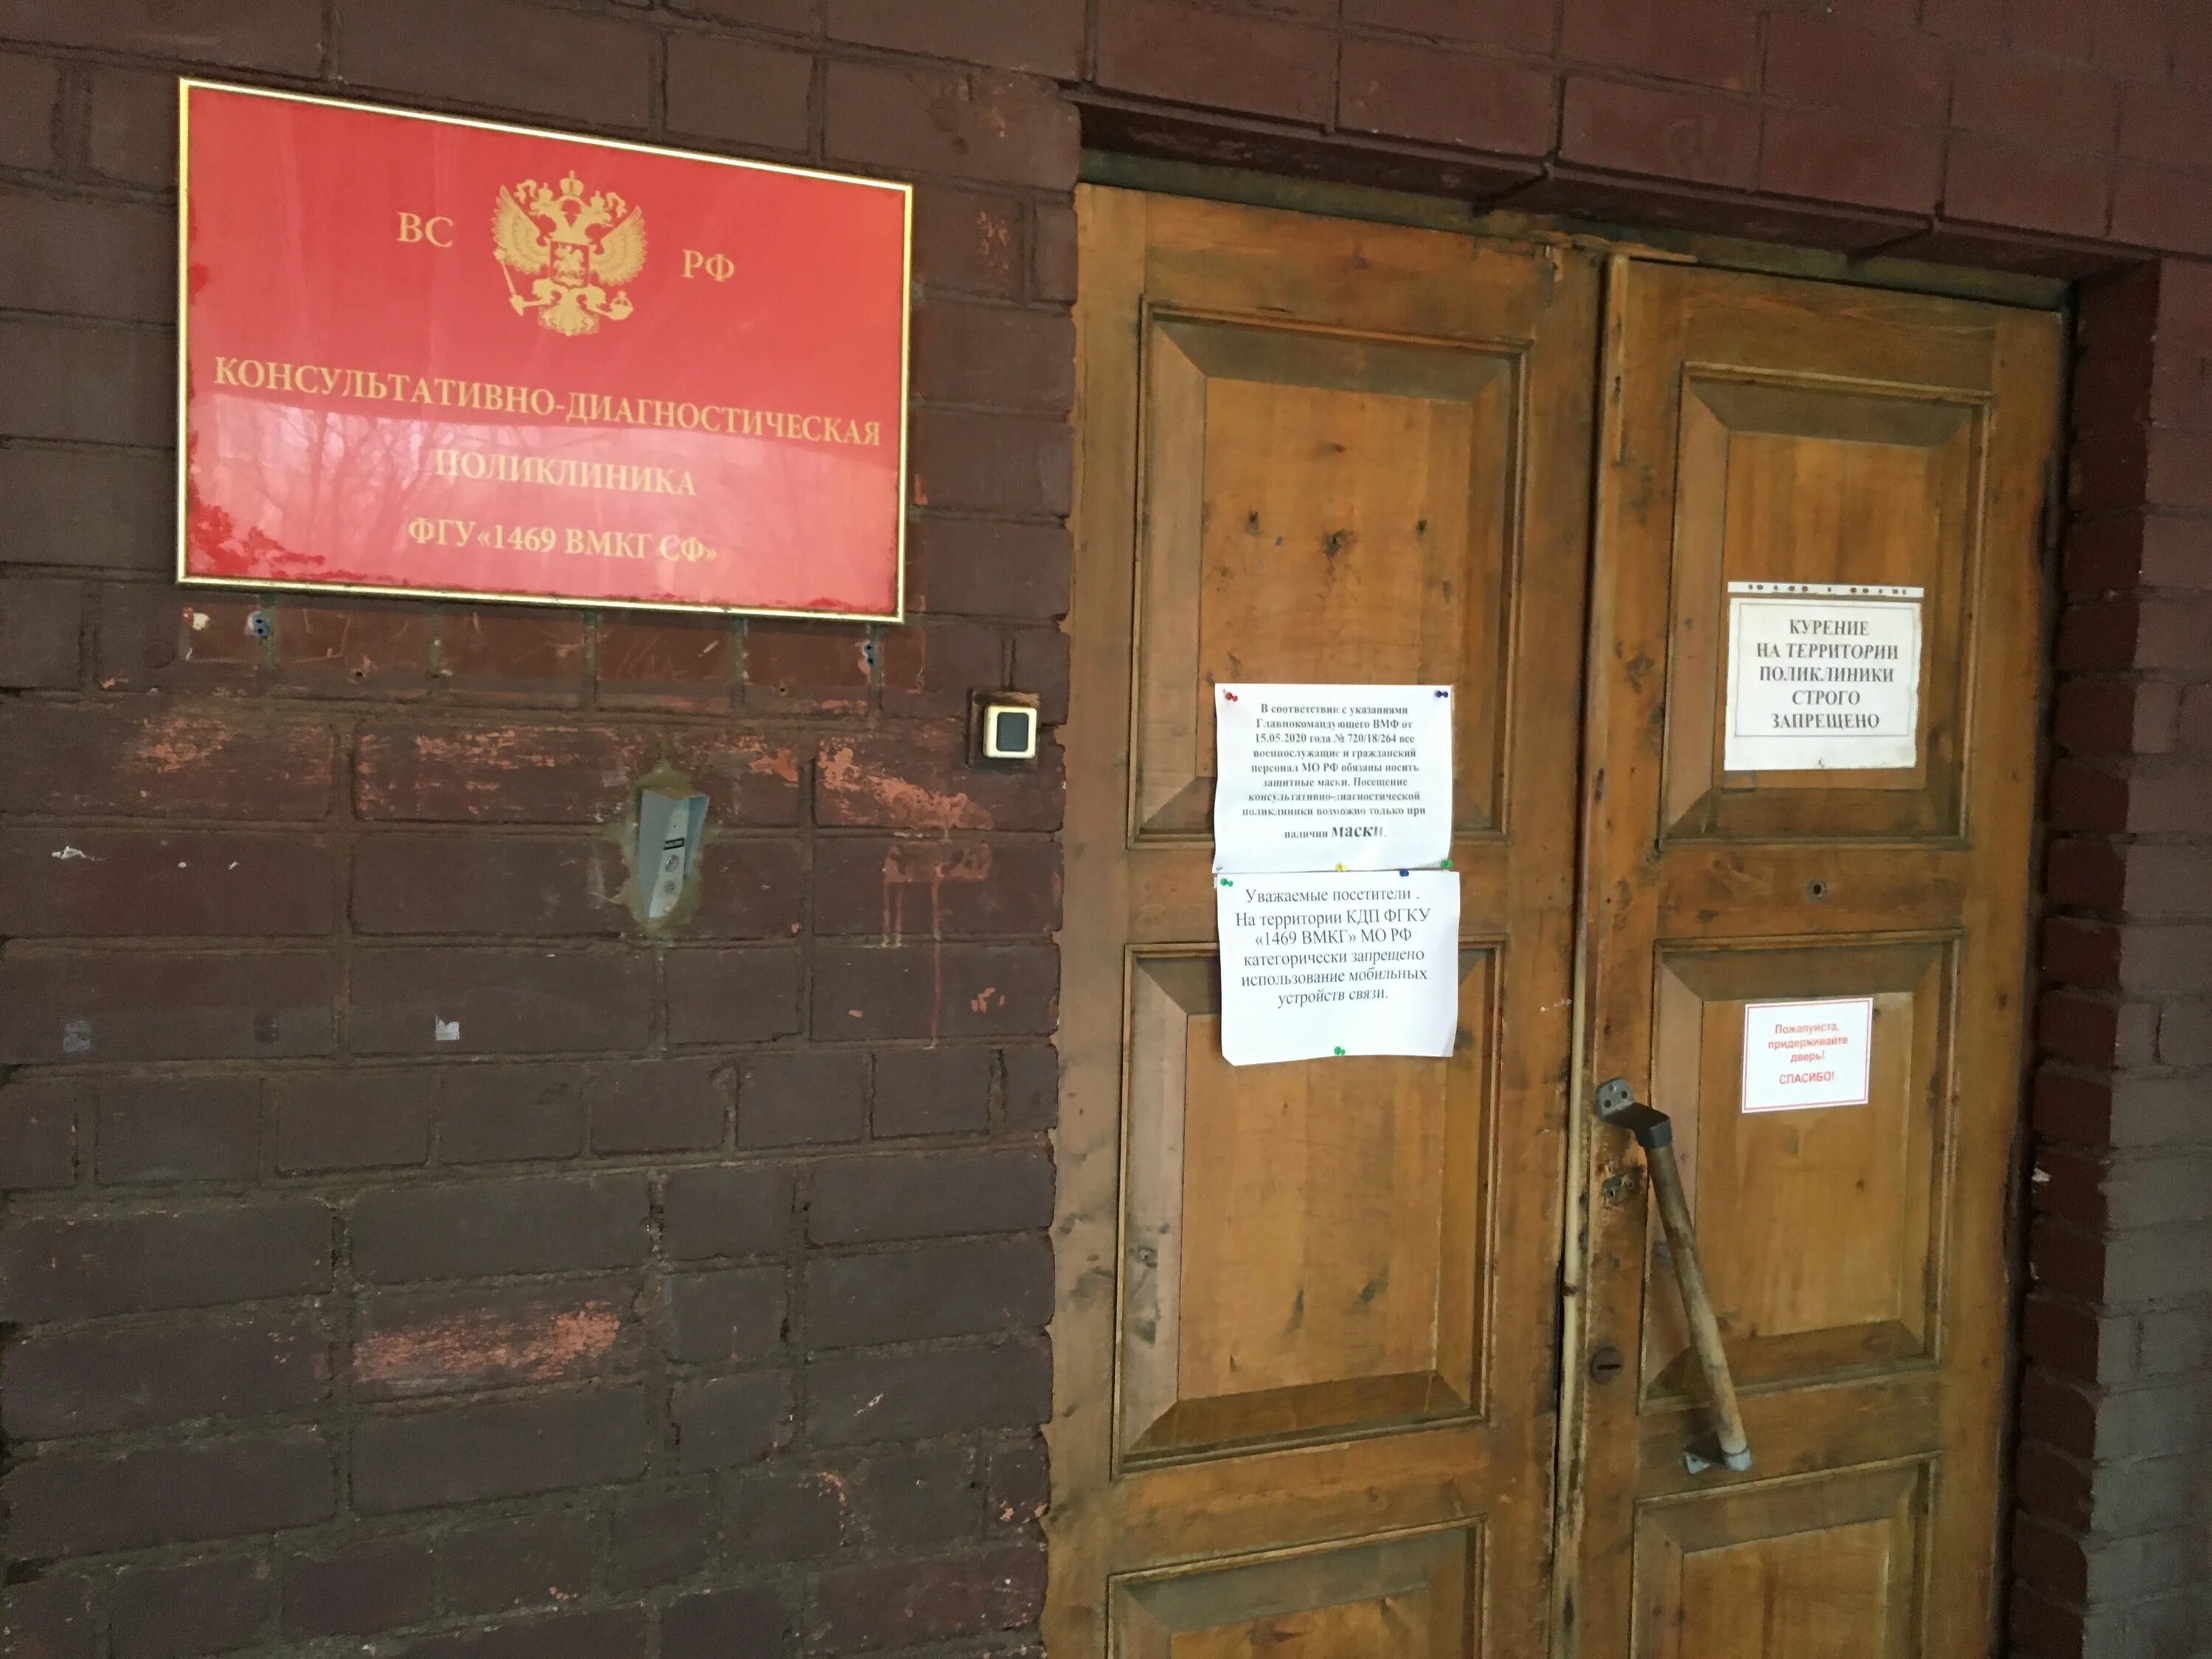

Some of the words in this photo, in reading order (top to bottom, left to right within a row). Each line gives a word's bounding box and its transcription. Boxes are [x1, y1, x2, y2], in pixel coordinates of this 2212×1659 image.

[396, 212, 454, 248] ВС
[681, 249, 735, 282] РФ
[214, 358, 881, 447] КОНСУЛЬТАТИВНО-ДИАГНОСТИЧЕСКАЯ
[435, 448, 695, 496] ПОЛИКЛИНИКА
[565, 532, 647, 560] ВМКГ
[661, 535, 717, 563] СФ»
[1790, 619, 1870, 636] КУРЕНИЕ
[1756, 643, 1780, 658] НА
[1787, 643, 1898, 659] ТЕРРИТОРИИ
[1759, 666, 1893, 682] ПОЛИКЛИНИКИ
[1792, 690, 1860, 705] СТРОГО
[1261, 704, 1268, 713] В
[1271, 705, 1338, 714] соответствии
[1350, 706, 1408, 717] указаниями
[1256, 719, 1370, 731] Главнокомандующего
[1373, 720, 1399, 728] ВМФ
[1771, 714, 1880, 730] ЗАПРЕЩЕНО
[1256, 733, 1307, 743] 15.05.2020
[1310, 735, 1331, 744] года
[1334, 734, 1345, 743] №
[1348, 734, 1397, 743] 720/18/264
[1399, 735, 1414, 743] все
[1253, 748, 1340, 759] военнослужащие
[1352, 747, 1416, 759] гражданский
[1251, 764, 1298, 775] персонал
[1302, 762, 1320, 772] МО
[1324, 762, 1338, 772] РФ
[1341, 763, 1382, 772] обязаны
[1263, 779, 1314, 789] защитные
[1318, 779, 1350, 787] маски.
[1353, 776, 1408, 787] Посещение
[1248, 792, 1420, 804] консультативно-диагностической
[1242, 807, 1313, 816] поликлиники
[1317, 807, 1366, 816] возможно
[1369, 807, 1404, 815] только
[1407, 807, 1425, 817] при
[1284, 830, 1328, 839] наличии
[1332, 826, 1386, 838] маски.
[1245, 888, 1328, 904] Уважаемые
[1333, 888, 1411, 902] посетители
[1236, 913, 1255, 926] На
[1259, 912, 1341, 929] территории
[1347, 910, 1380, 925] КДП
[1384, 908, 1430, 922] ФГКУ
[1255, 930, 1296, 946] «1469
[1302, 929, 1356, 945] ВМКГ»
[1361, 928, 1386, 942] МО
[1391, 928, 1412, 941] РФ
[1244, 951, 1347, 968] категорически
[1352, 948, 1425, 964] запрещено
[1242, 971, 1345, 987] использование
[1349, 967, 1427, 981] мобильных
[1278, 989, 1345, 1009] устройств
[1349, 987, 1388, 1001] связи.
[1775, 1023, 1839, 1034] Пожалуйста,
[1768, 1036, 1848, 1050] придерживайте
[1790, 1051, 1825, 1063] дверь!
[1779, 1071, 1834, 1085] СПАСИБО!
